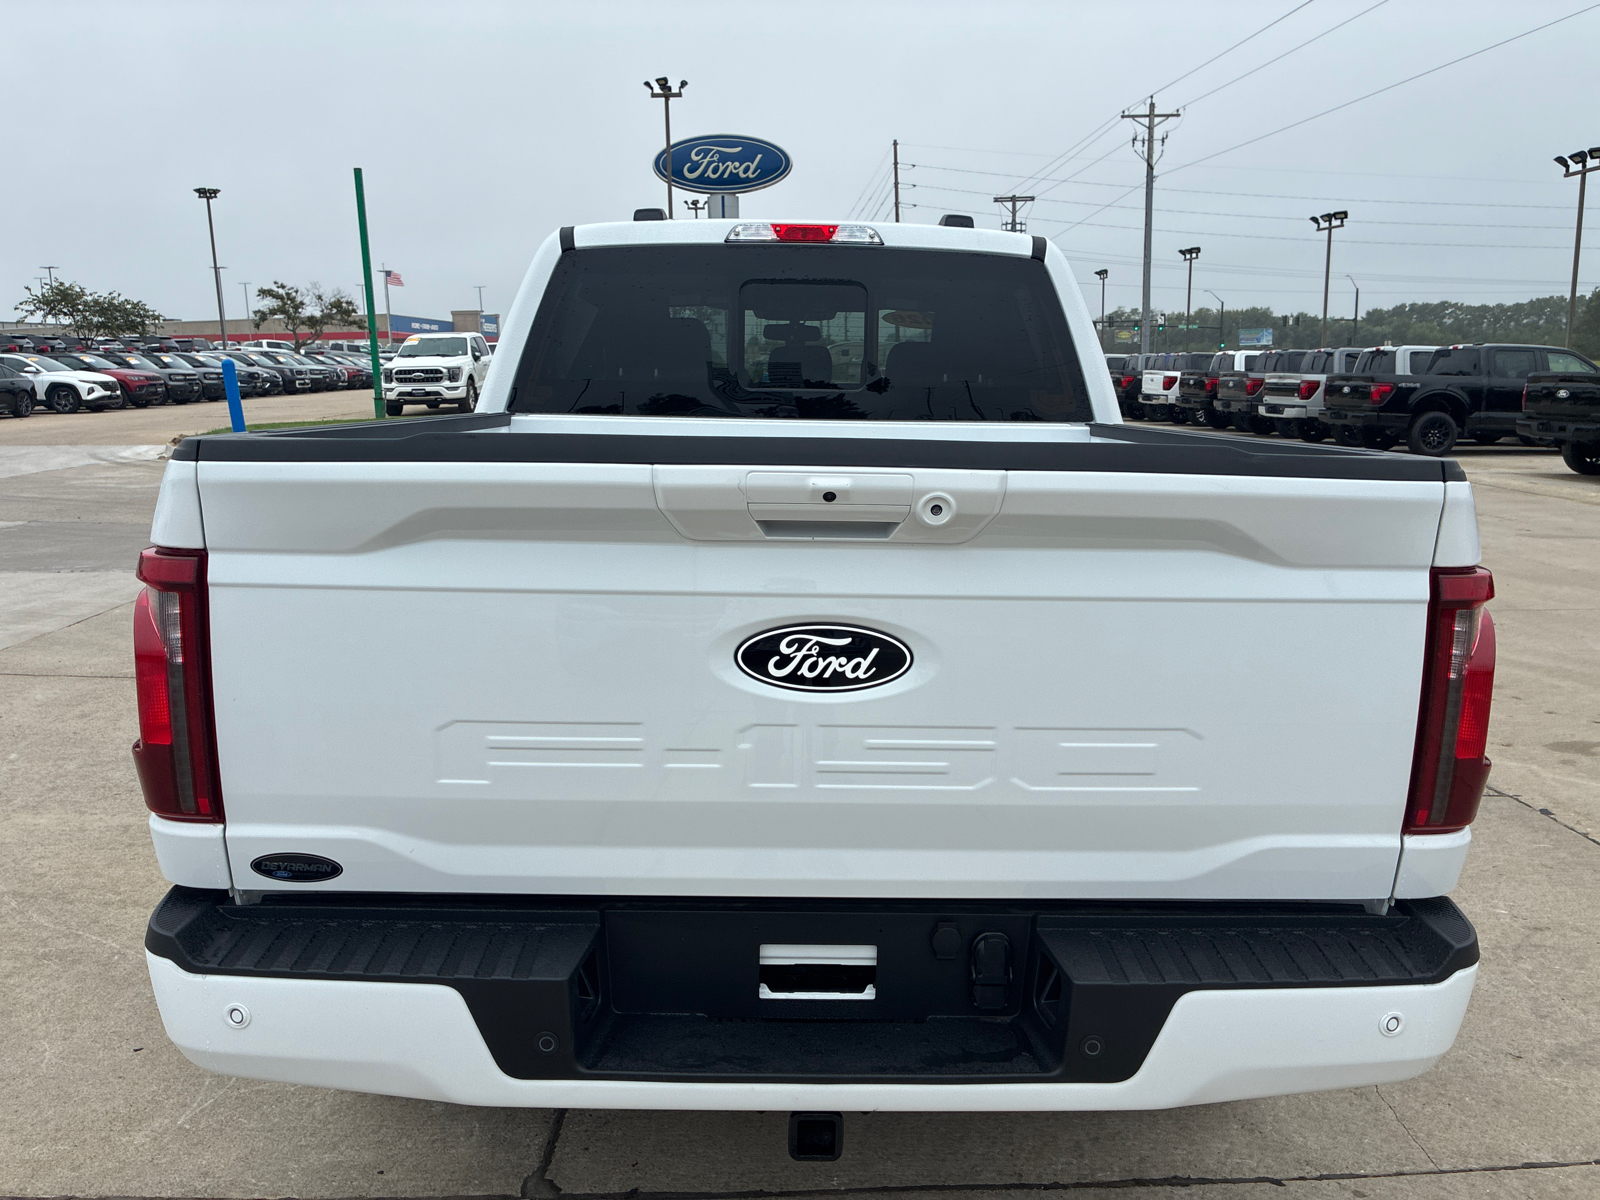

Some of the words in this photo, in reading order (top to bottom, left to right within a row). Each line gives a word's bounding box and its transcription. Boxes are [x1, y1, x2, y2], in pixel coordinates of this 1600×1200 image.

[683, 145, 763, 179] Ford
[767, 634, 880, 679] Ford
[435, 720, 1204, 792] F-150
[261, 861, 332, 872] DEYARMAN
